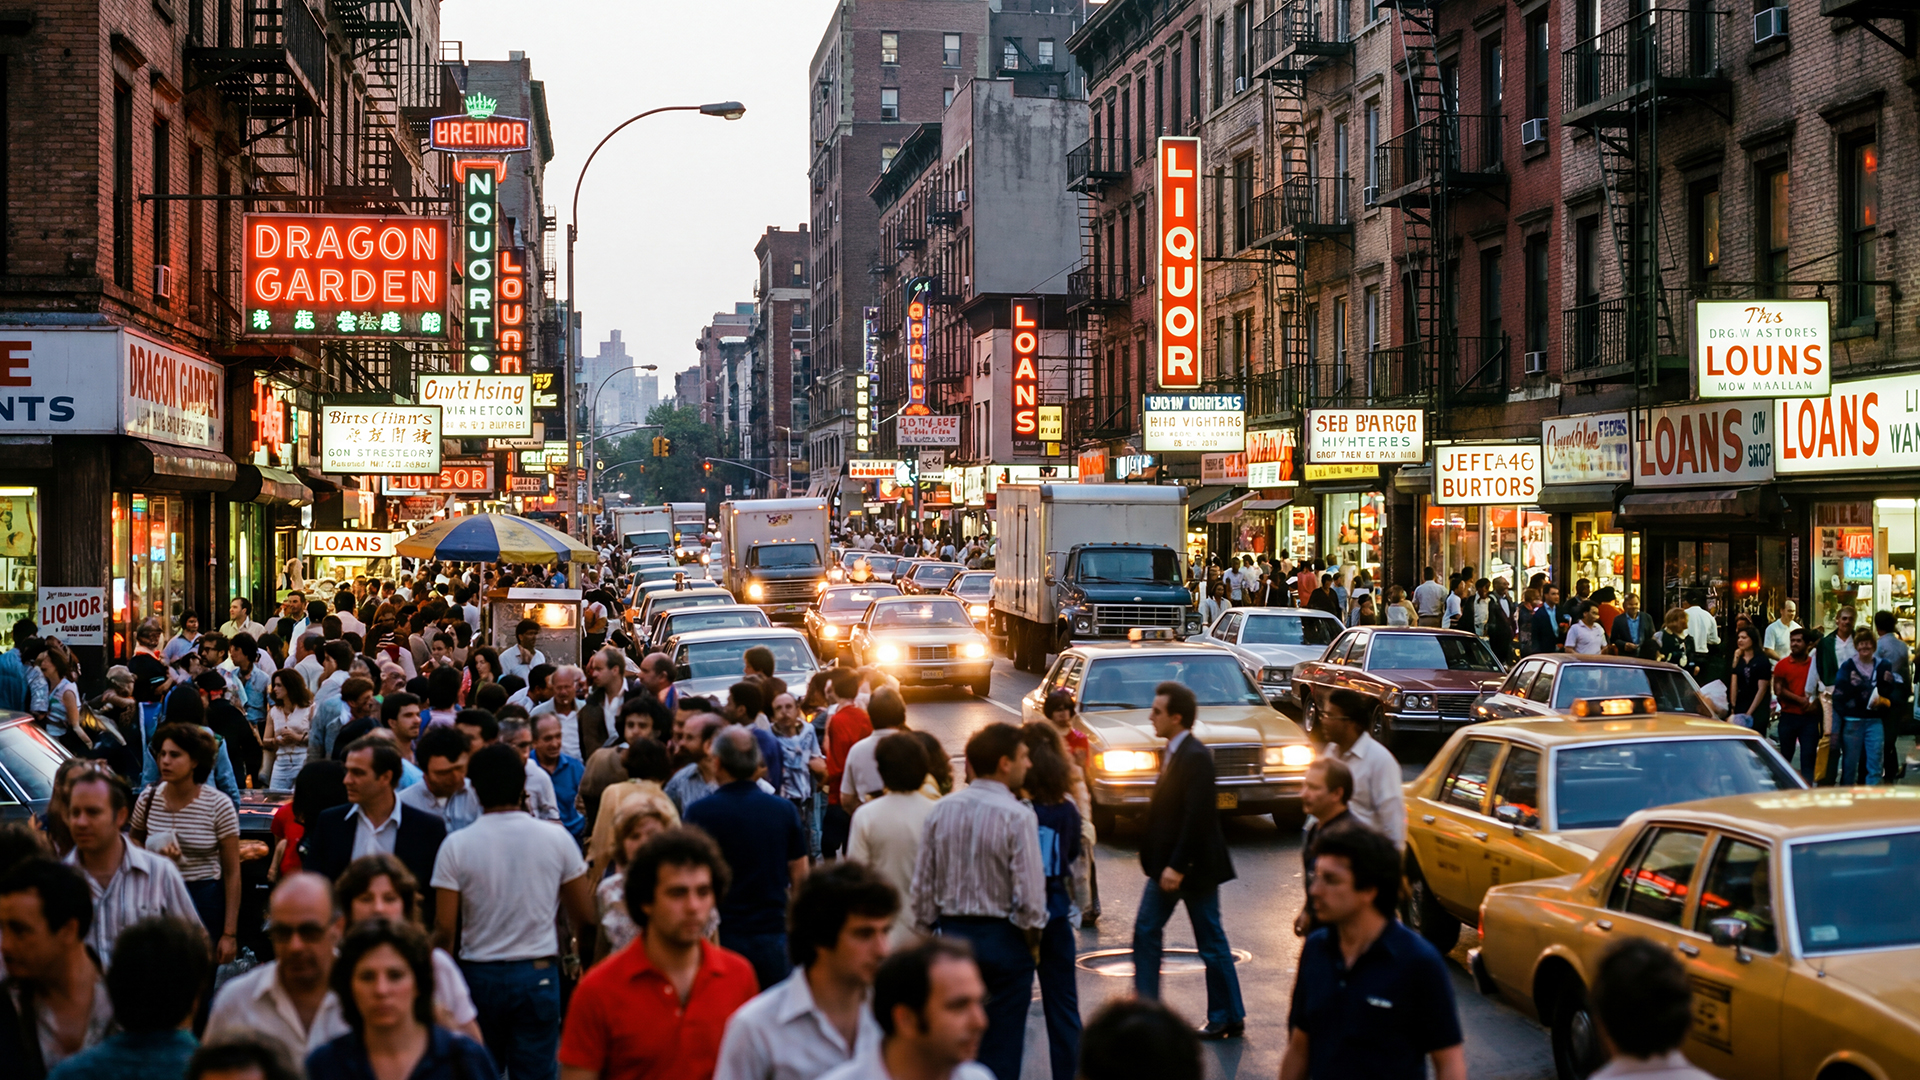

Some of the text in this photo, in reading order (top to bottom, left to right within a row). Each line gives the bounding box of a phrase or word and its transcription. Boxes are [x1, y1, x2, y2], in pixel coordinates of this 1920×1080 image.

[255, 224, 437, 260] DRAGON
[1165, 147, 1195, 376] LIQUOR
[255, 267, 437, 303] GARDEN
[1014, 305, 1037, 433] LOANS
[1706, 344, 1823, 376] LOUNS
[130, 343, 176, 408] DRAGON
[180, 362, 219, 419] GARDEN
[1641, 408, 1744, 476] LOANS
[1783, 391, 1880, 460] LOANS
[1748, 441, 1772, 467] SHOP
[1443, 476, 1535, 497] BURTORS
[314, 536, 382, 552] LOANS
[42, 595, 101, 626] LIQUOR
